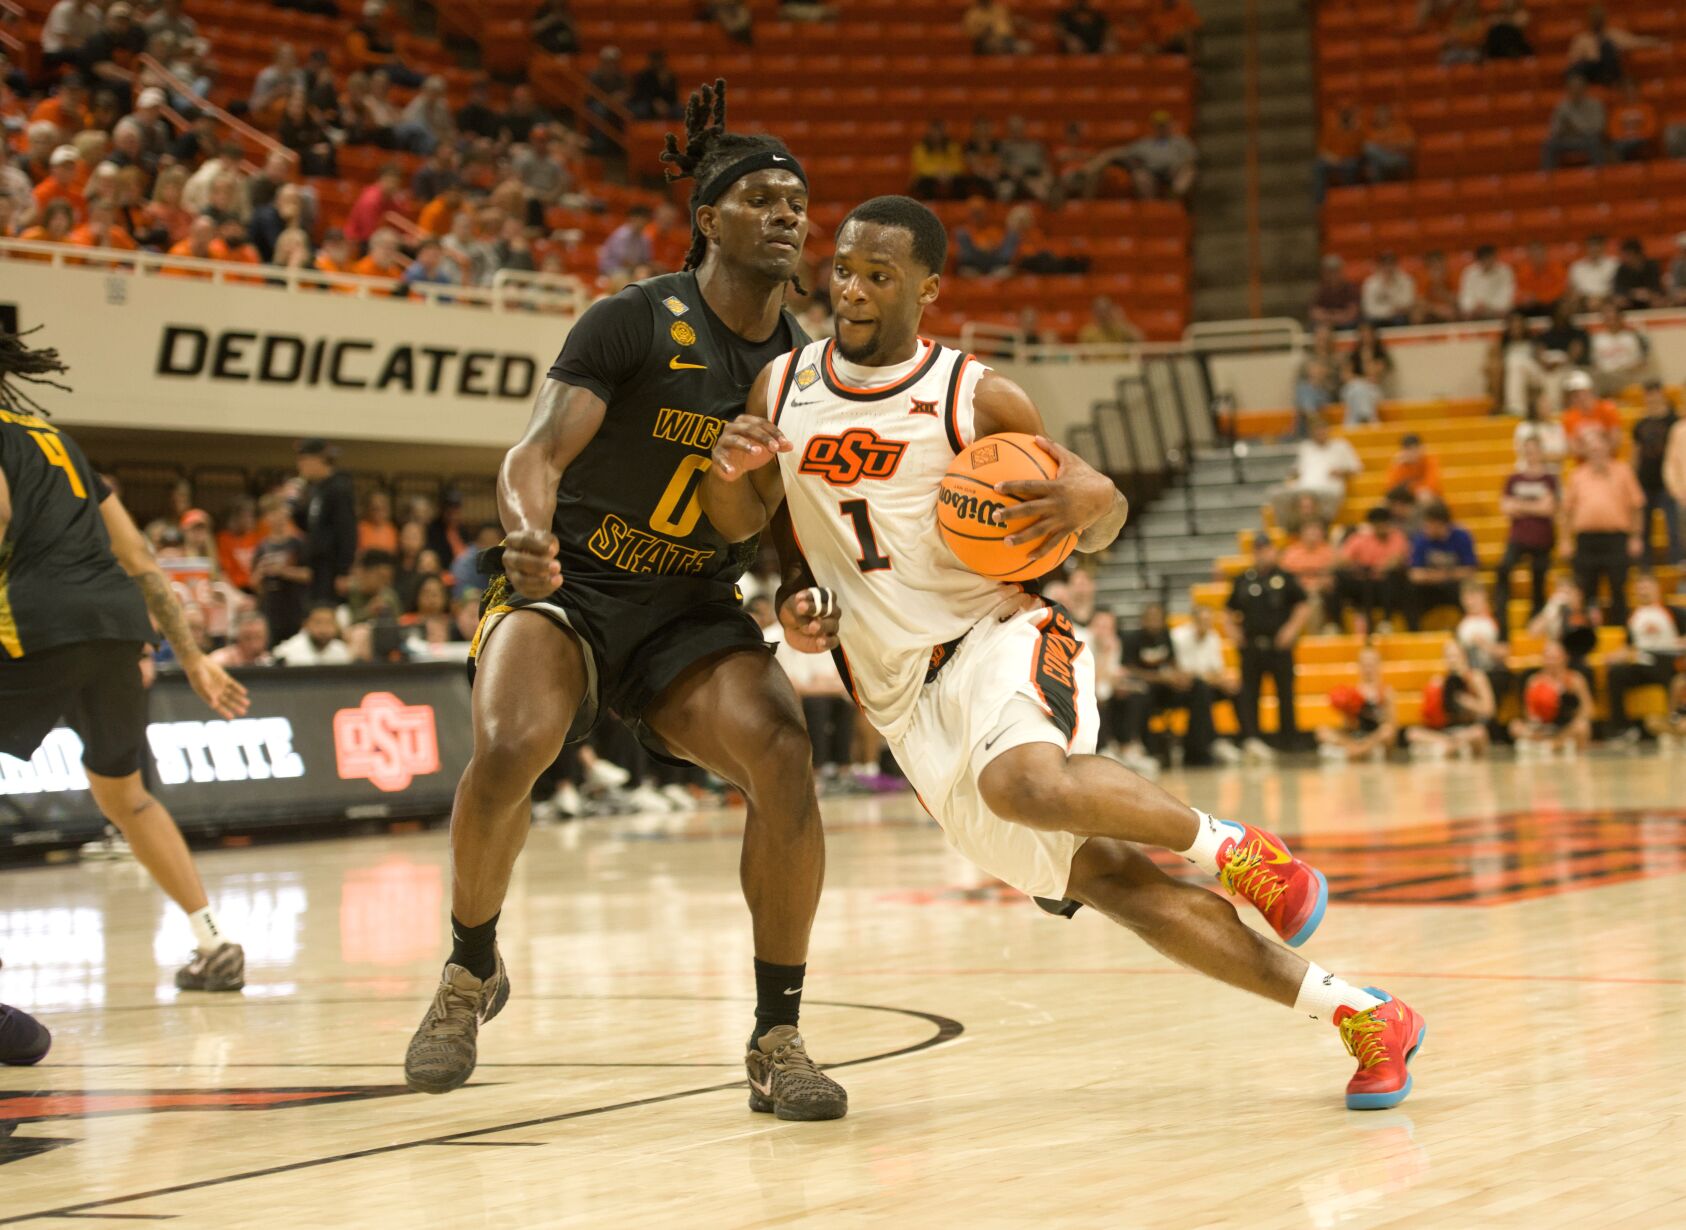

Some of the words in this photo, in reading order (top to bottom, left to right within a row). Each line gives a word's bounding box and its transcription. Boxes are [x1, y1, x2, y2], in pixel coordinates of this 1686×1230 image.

[155, 325, 538, 399] DEDICATED
[26, 429, 89, 499] 4
[652, 408, 728, 450] WIC
[798, 427, 911, 487] OSU
[649, 454, 713, 538] 0
[838, 497, 892, 573] 1
